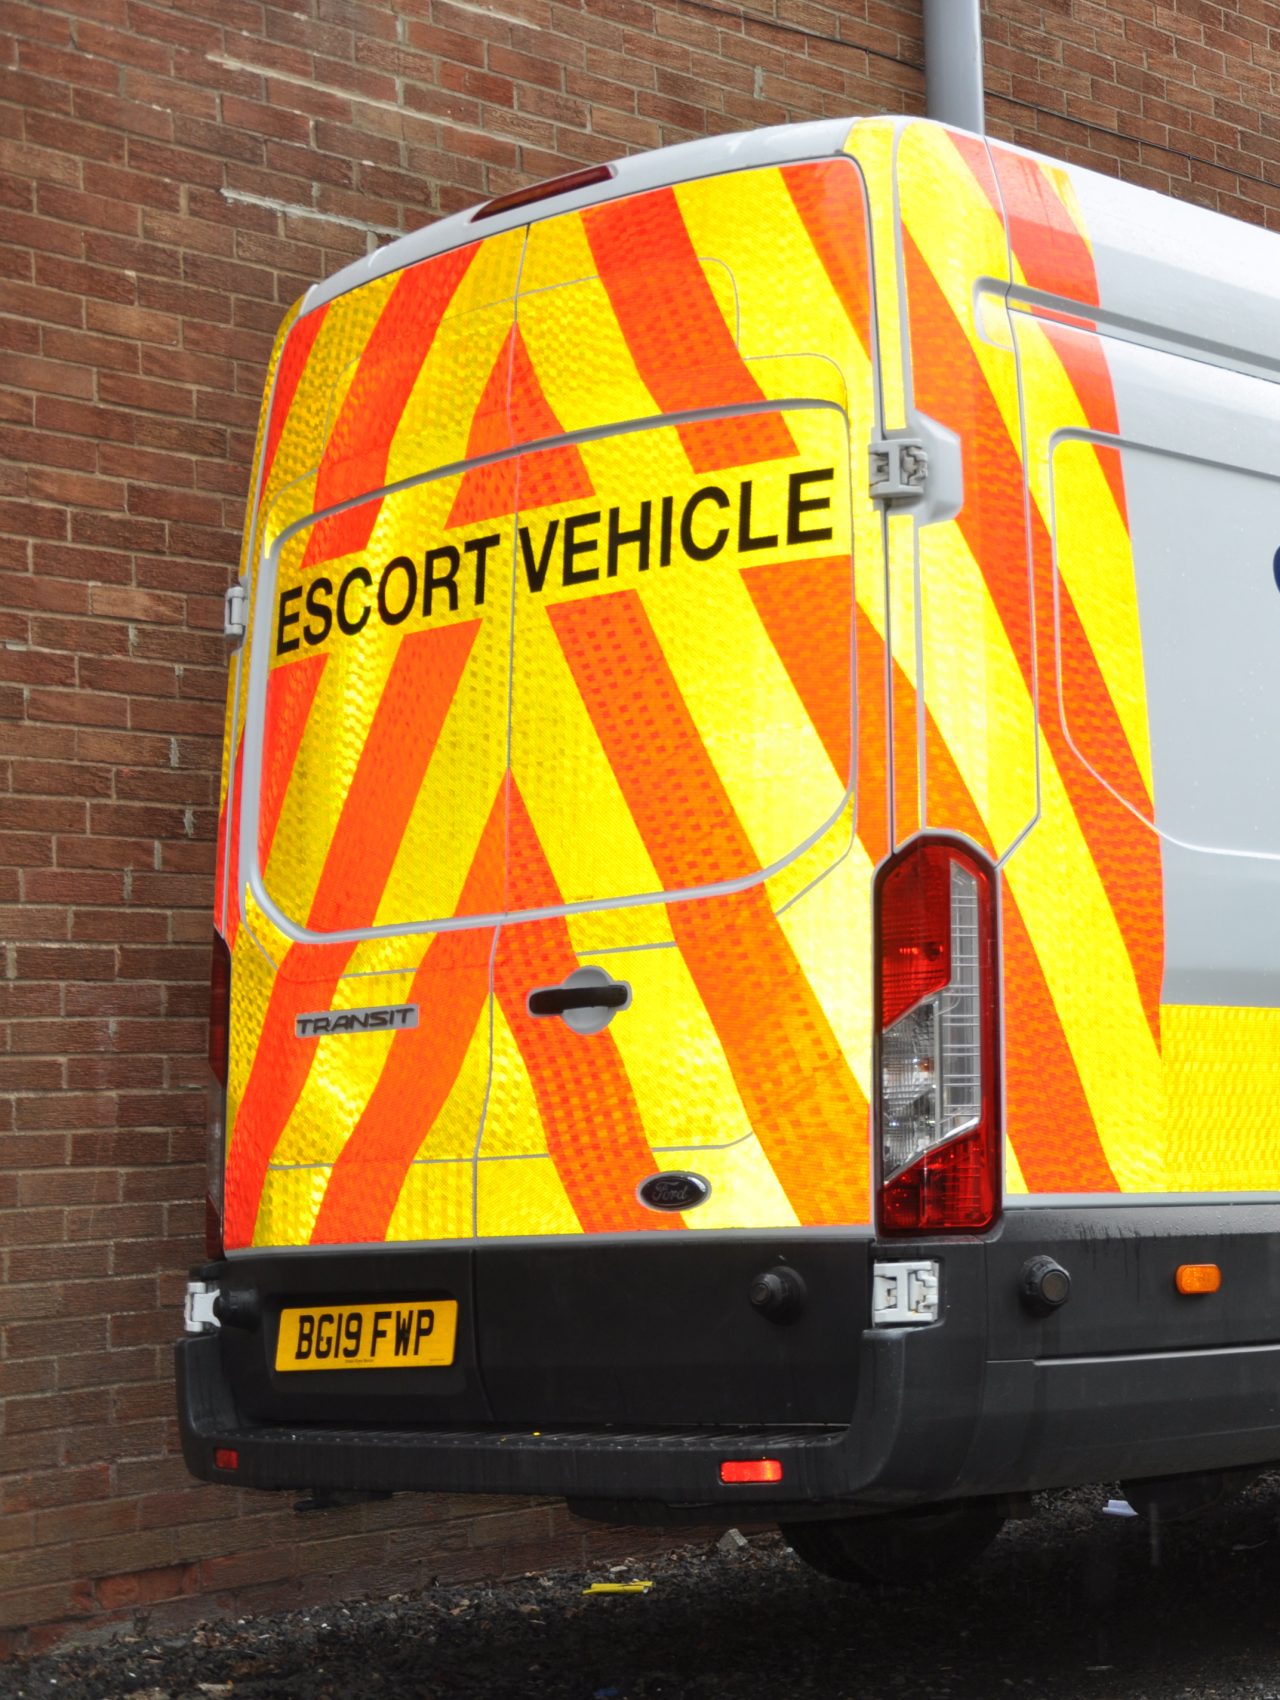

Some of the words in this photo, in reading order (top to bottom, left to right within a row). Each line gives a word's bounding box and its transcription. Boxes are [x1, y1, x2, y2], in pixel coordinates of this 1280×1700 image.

[276, 534, 500, 656] ESCORT
[518, 468, 834, 594] VEHICLE
[297, 1008, 415, 1034] TRANSIT
[652, 1181, 688, 1200] Ford
[295, 1312, 363, 1360] BG19
[370, 1309, 434, 1357] FWP
